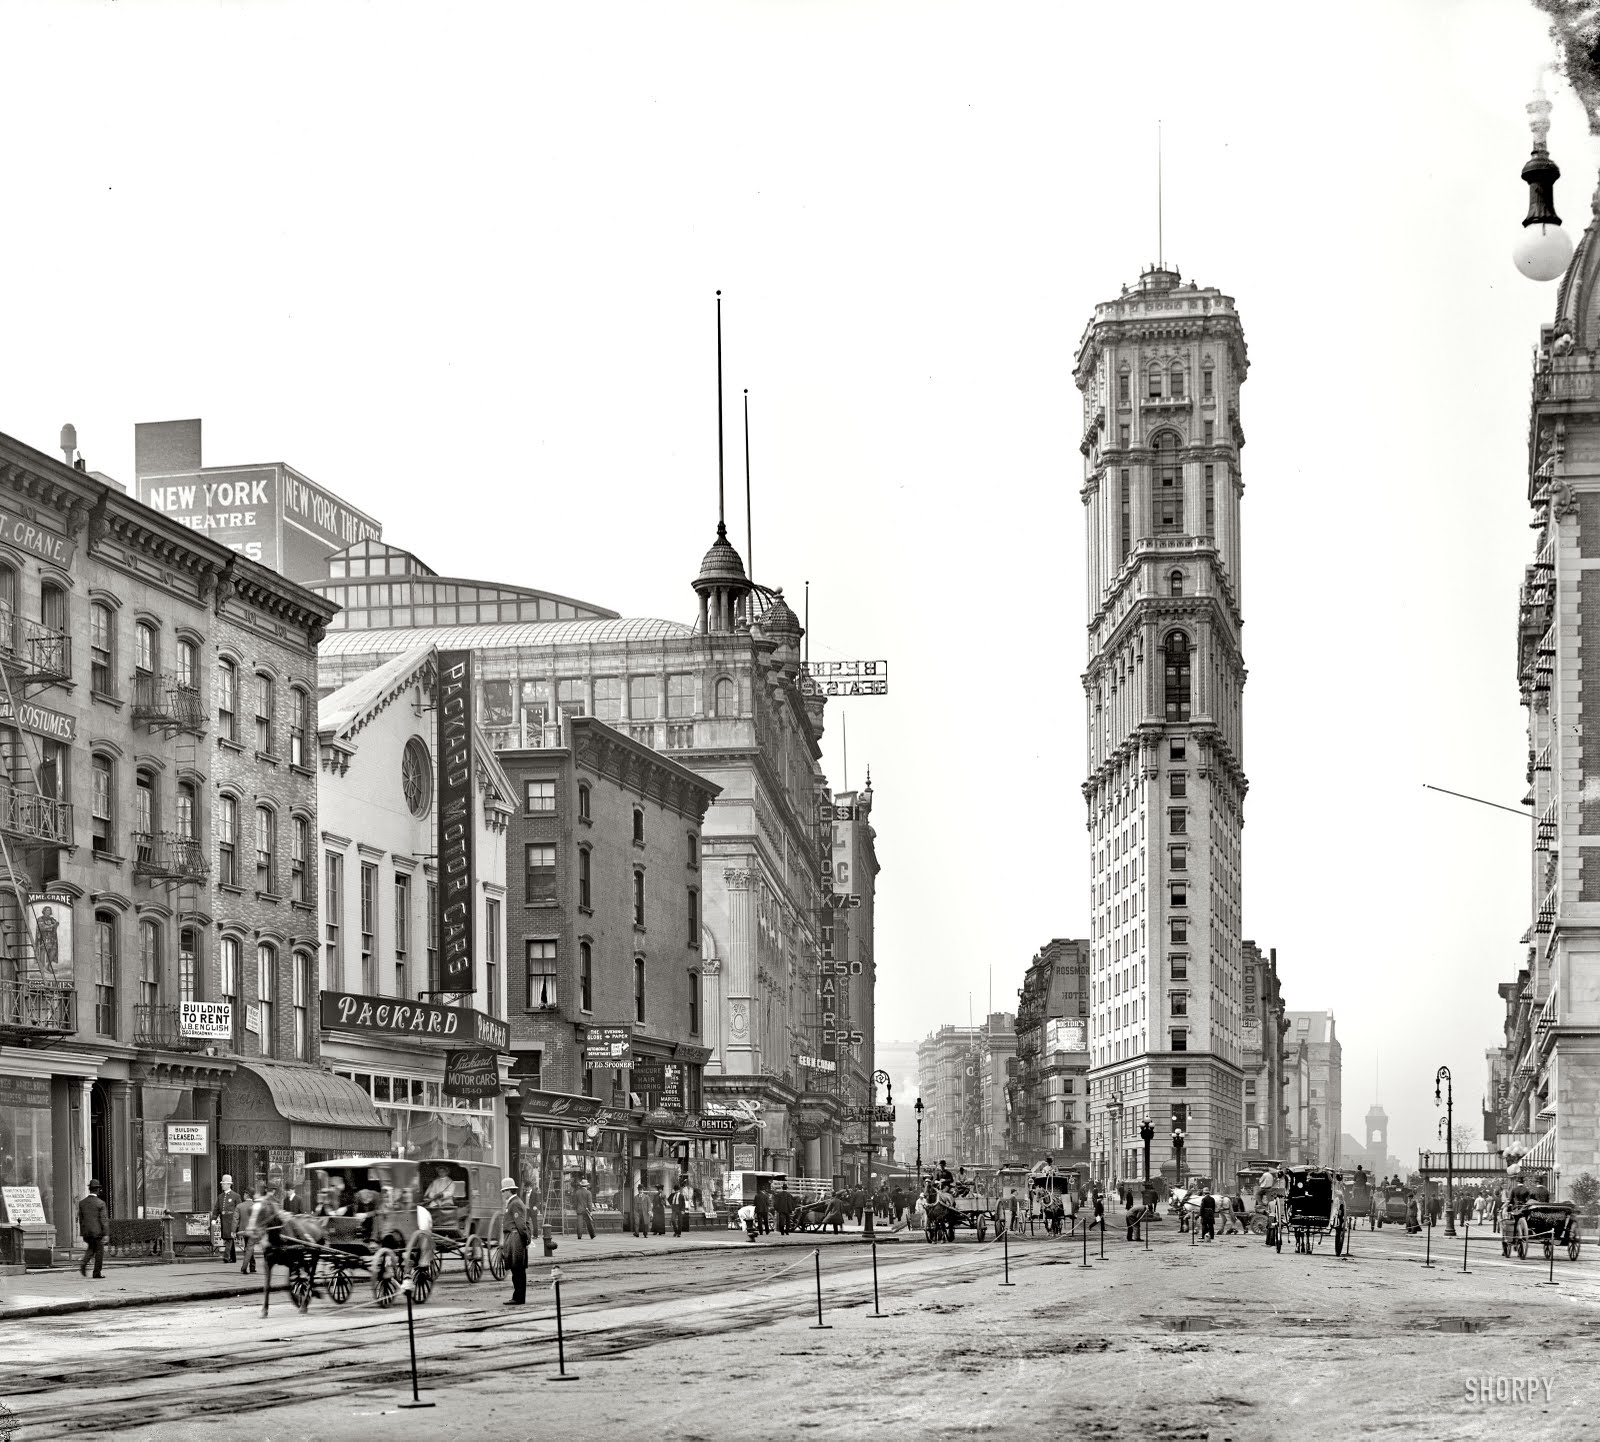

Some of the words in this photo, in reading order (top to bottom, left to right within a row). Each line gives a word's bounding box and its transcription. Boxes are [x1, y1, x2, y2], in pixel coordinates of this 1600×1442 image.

[150, 485, 196, 512] NEW
[203, 480, 269, 507] YORK
[285, 475, 309, 518] NEW
[310, 490, 337, 535] YORK
[174, 512, 257, 530] HEATRE
[14, 522, 66, 563] CRANE.
[20, 704, 72, 739] COSTUMES.
[442, 662, 468, 787] PACKARD
[820, 788, 832, 837] NEW
[442, 797, 468, 895] MOTOR
[820, 842, 833, 908] YORK
[835, 894, 861, 909] 75
[443, 902, 469, 974] CARS
[836, 961, 862, 975] 50
[1056, 966, 1090, 975] ROSSMOR
[821, 926, 836, 1044] THEATRE
[1062, 991, 1089, 1000] HOTEL
[182, 1013, 197, 1023] TO
[200, 1014, 230, 1024] RENT
[183, 1004, 230, 1014] BUILDING
[338, 996, 458, 1034] PACKARD
[477, 1014, 506, 1048] PACKARD
[836, 1030, 864, 1045] 25
[448, 1072, 475, 1086] MOTOR
[475, 1072, 497, 1086] CARS
[701, 1119, 734, 1130] DENTIST.
[840, 1106, 860, 1116] NEW
